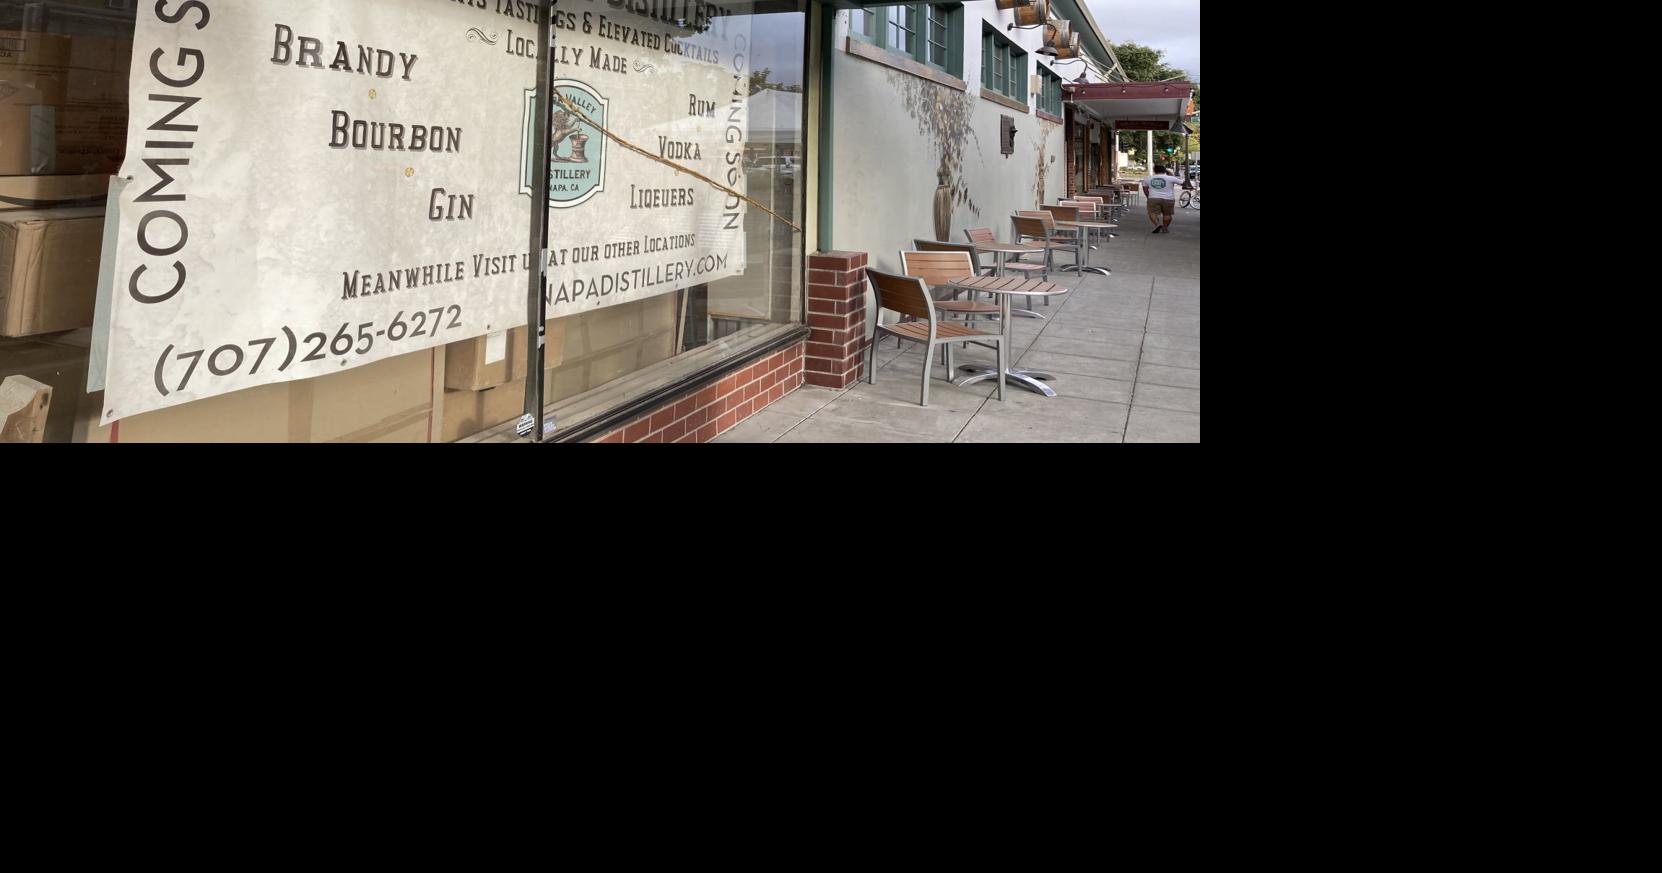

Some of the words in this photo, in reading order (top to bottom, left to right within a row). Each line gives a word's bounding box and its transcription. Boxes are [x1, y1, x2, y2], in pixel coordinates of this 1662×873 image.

[495, 0, 577, 31] TASTIGS
[582, 11, 592, 34] &
[598, 14, 661, 51] ELEVATED
[606, 0, 729, 40] TILLERY
[270, 23, 420, 82] BRANDY
[505, 29, 584, 66] LOCLY
[589, 45, 628, 74] MADE
[565, 93, 597, 114] VALLEY
[688, 93, 716, 118] RUM
[328, 109, 464, 153] BOURBON
[658, 135, 702, 161] VODKA
[128, 47, 206, 304] COMING
[549, 169, 592, 180] STILLERY
[570, 183, 580, 192] CA
[722, 151, 742, 230] SOON
[428, 187, 475, 221] GIN
[629, 183, 695, 210] LIQEUERS
[340, 260, 466, 301] MEANWHILE
[472, 253, 517, 279] VISIT
[547, 248, 569, 267] AT
[572, 242, 600, 264] OUR
[604, 239, 641, 260] OTHER
[643, 233, 696, 254] LOCATIONS
[153, 303, 463, 398] (707)265-6272
